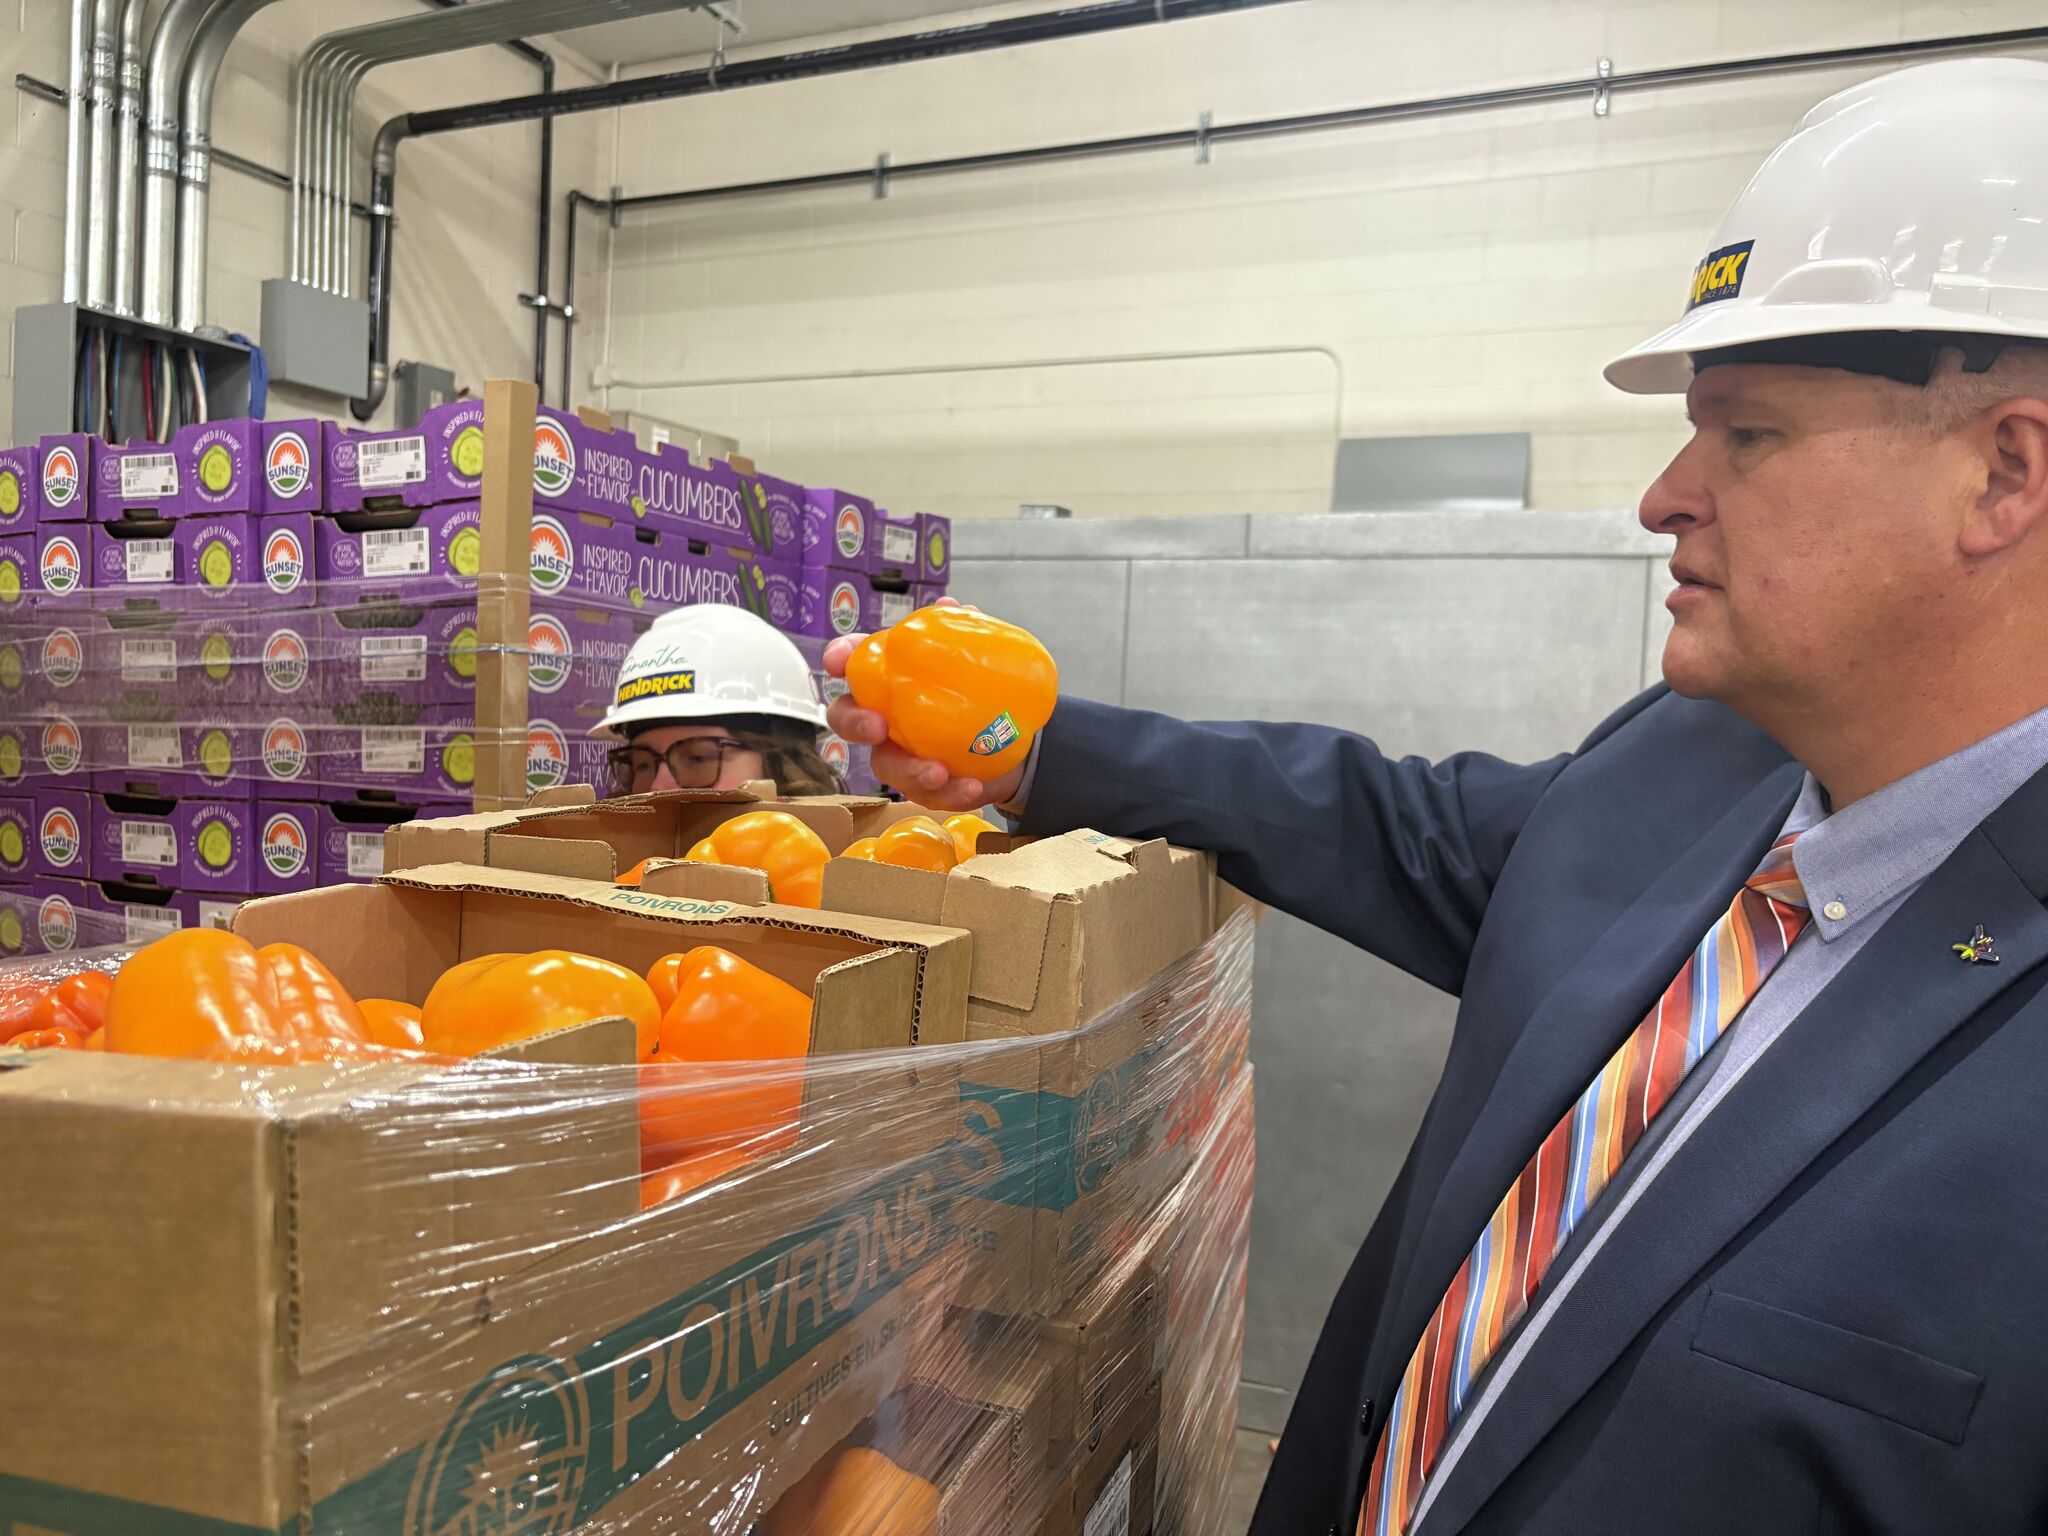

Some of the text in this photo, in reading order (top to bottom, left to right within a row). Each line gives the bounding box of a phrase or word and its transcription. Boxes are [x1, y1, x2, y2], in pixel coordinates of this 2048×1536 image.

[220, 430, 240, 453] FLAVOR
[269, 464, 307, 481] SUNSET
[534, 454, 574, 479] UNSET
[585, 448, 633, 482] INSPIRED
[45, 477, 77, 491] SUNSET
[588, 473, 630, 505] FLAVOR
[640, 465, 742, 529] CUCUMBERS
[266, 562, 302, 578] SUNSET
[530, 554, 572, 577] UNSET
[583, 544, 632, 574] INSPIRED
[43, 566, 79, 581] SUNSET
[586, 569, 628, 597] FLAVOR
[639, 556, 740, 608] CUCUMBERS
[529, 653, 572, 673] UNSET
[618, 674, 694, 704] HENDRICK
[527, 758, 568, 777] UNSET
[43, 835, 78, 850] SUNSET
[264, 844, 305, 859] SUNSET
[610, 892, 730, 914] POIVRONS
[612, 1171, 934, 1472] POIVRONS
